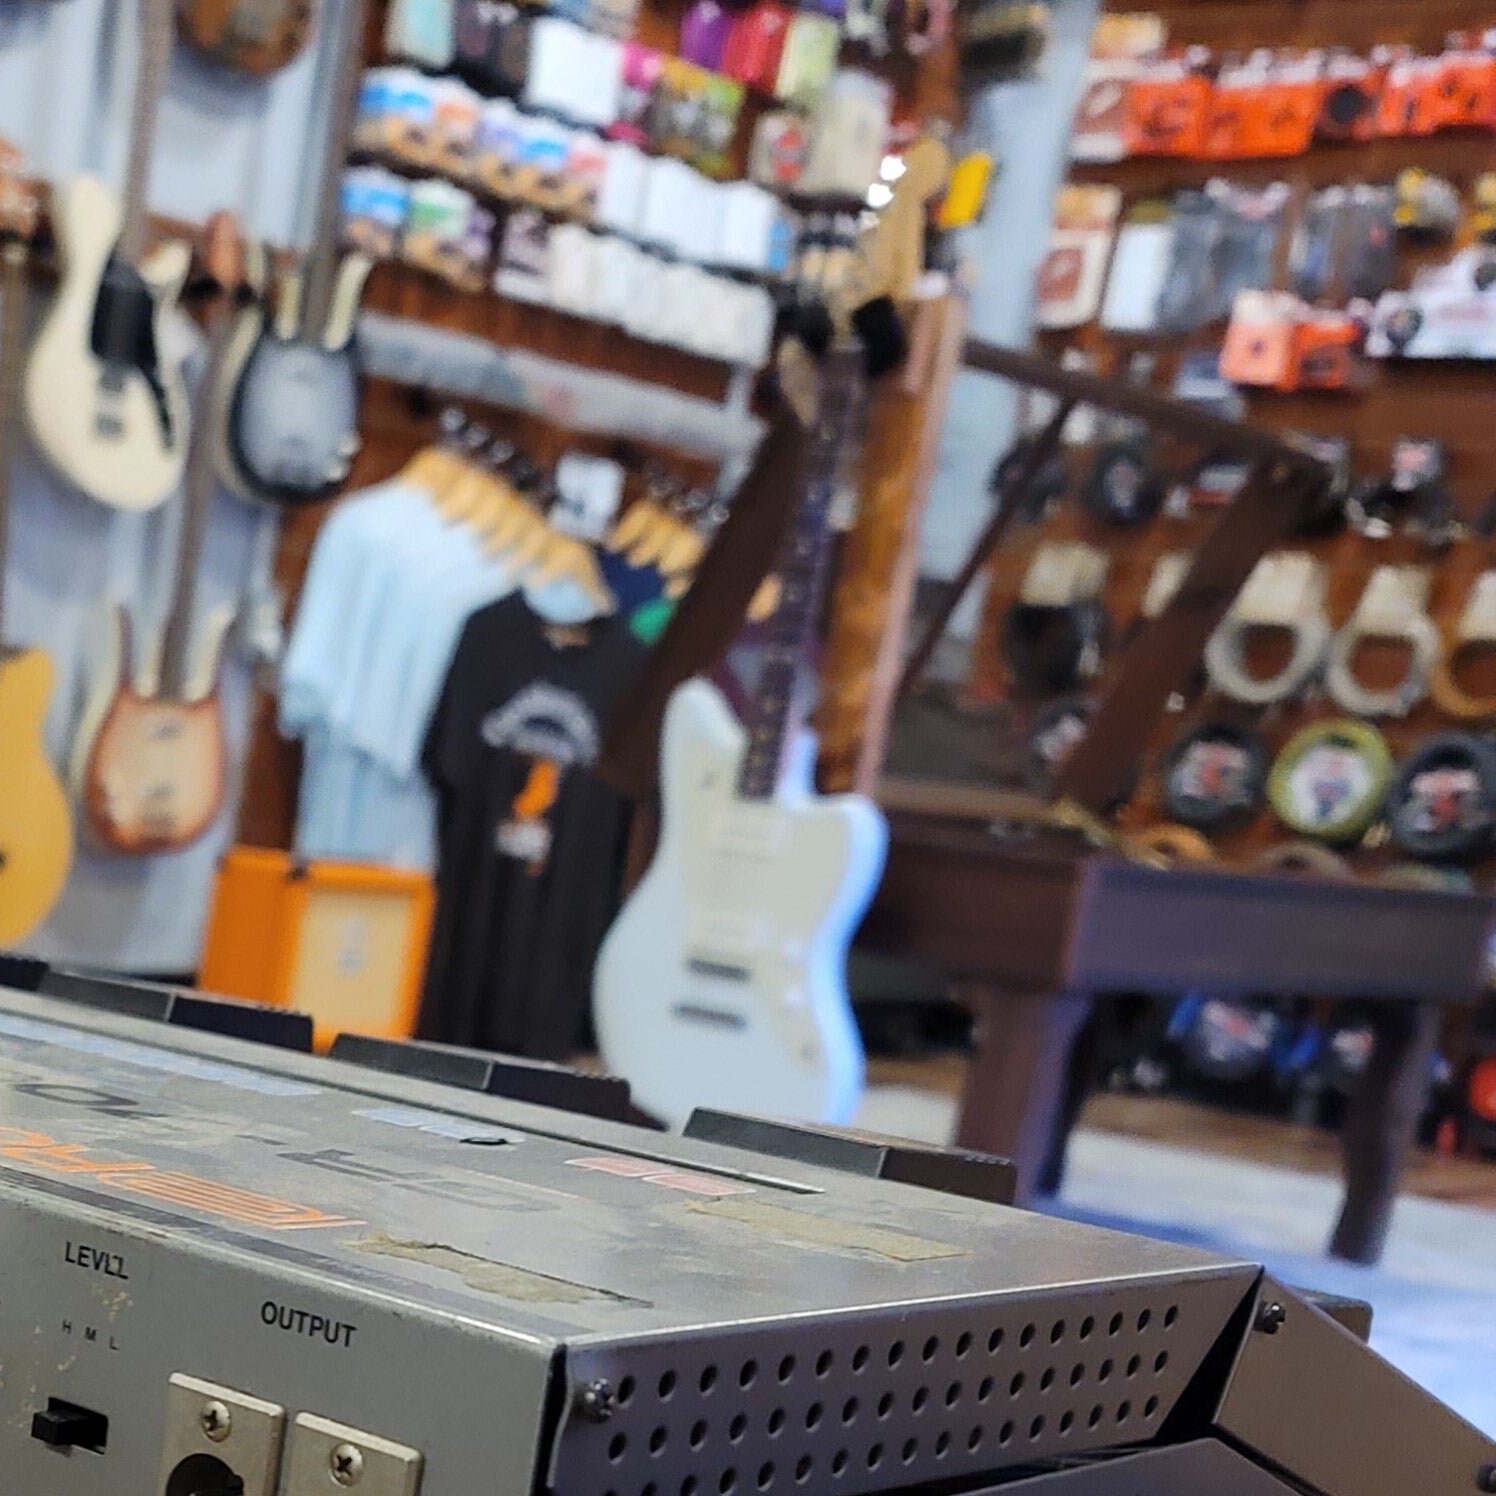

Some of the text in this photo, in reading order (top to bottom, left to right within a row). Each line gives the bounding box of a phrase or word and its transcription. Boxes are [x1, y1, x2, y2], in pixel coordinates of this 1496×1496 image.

[61, 1318, 121, 1351] H M L
[260, 1300, 361, 1349] OUTPUT
